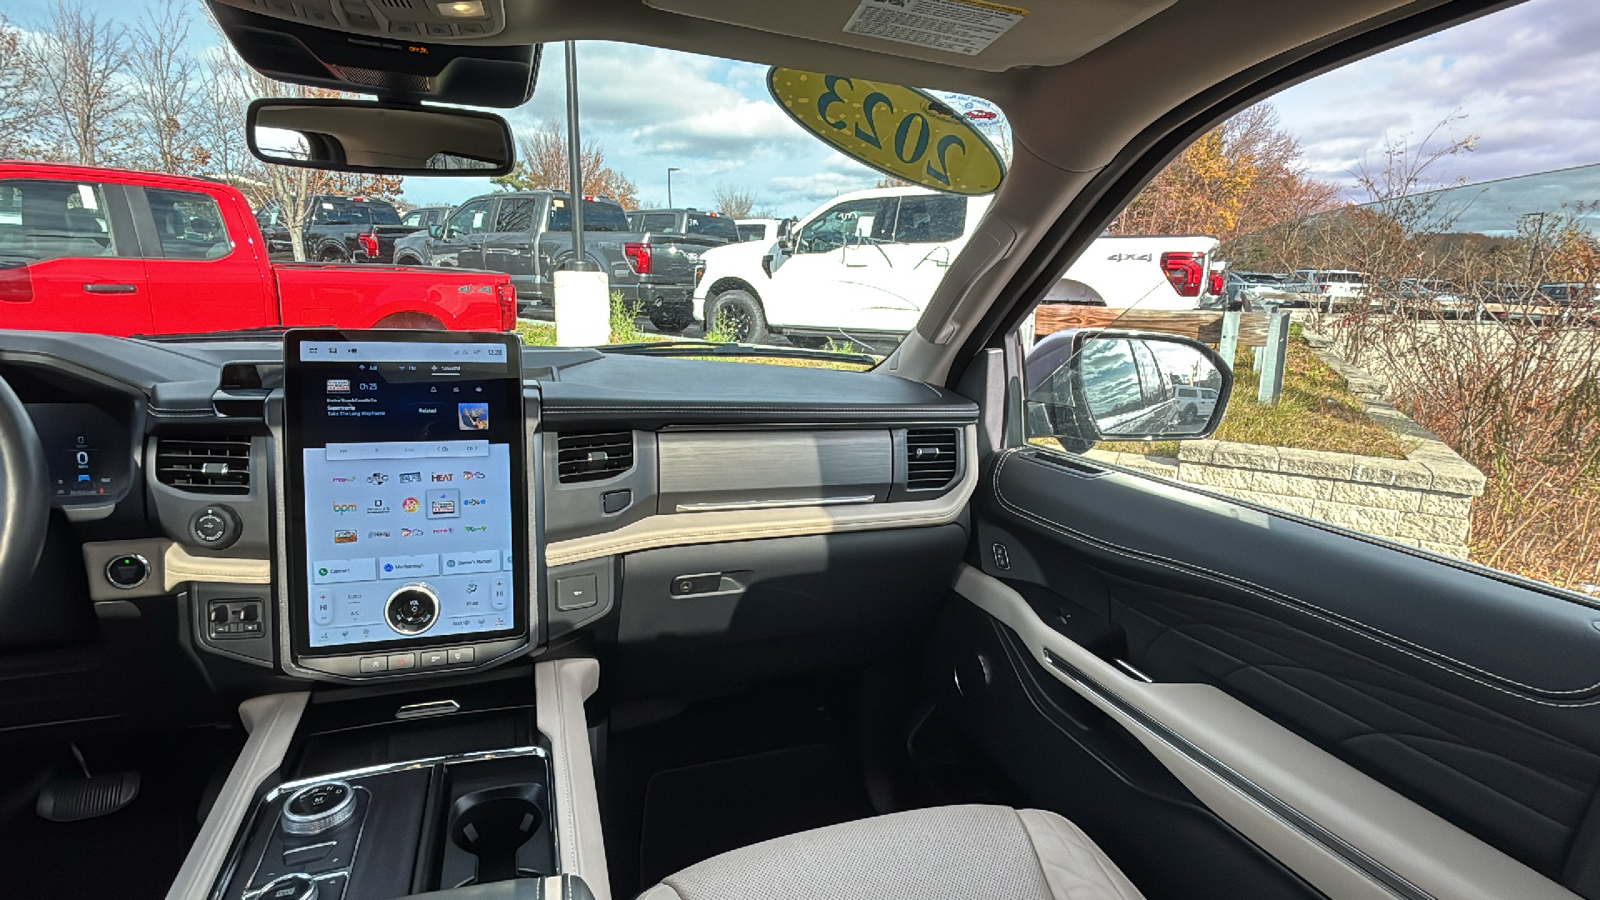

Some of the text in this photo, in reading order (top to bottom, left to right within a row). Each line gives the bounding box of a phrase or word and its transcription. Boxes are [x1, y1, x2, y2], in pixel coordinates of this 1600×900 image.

[76, 451, 89, 464] 0
[431, 473, 454, 482] HEAT
[332, 501, 357, 516] bpm
